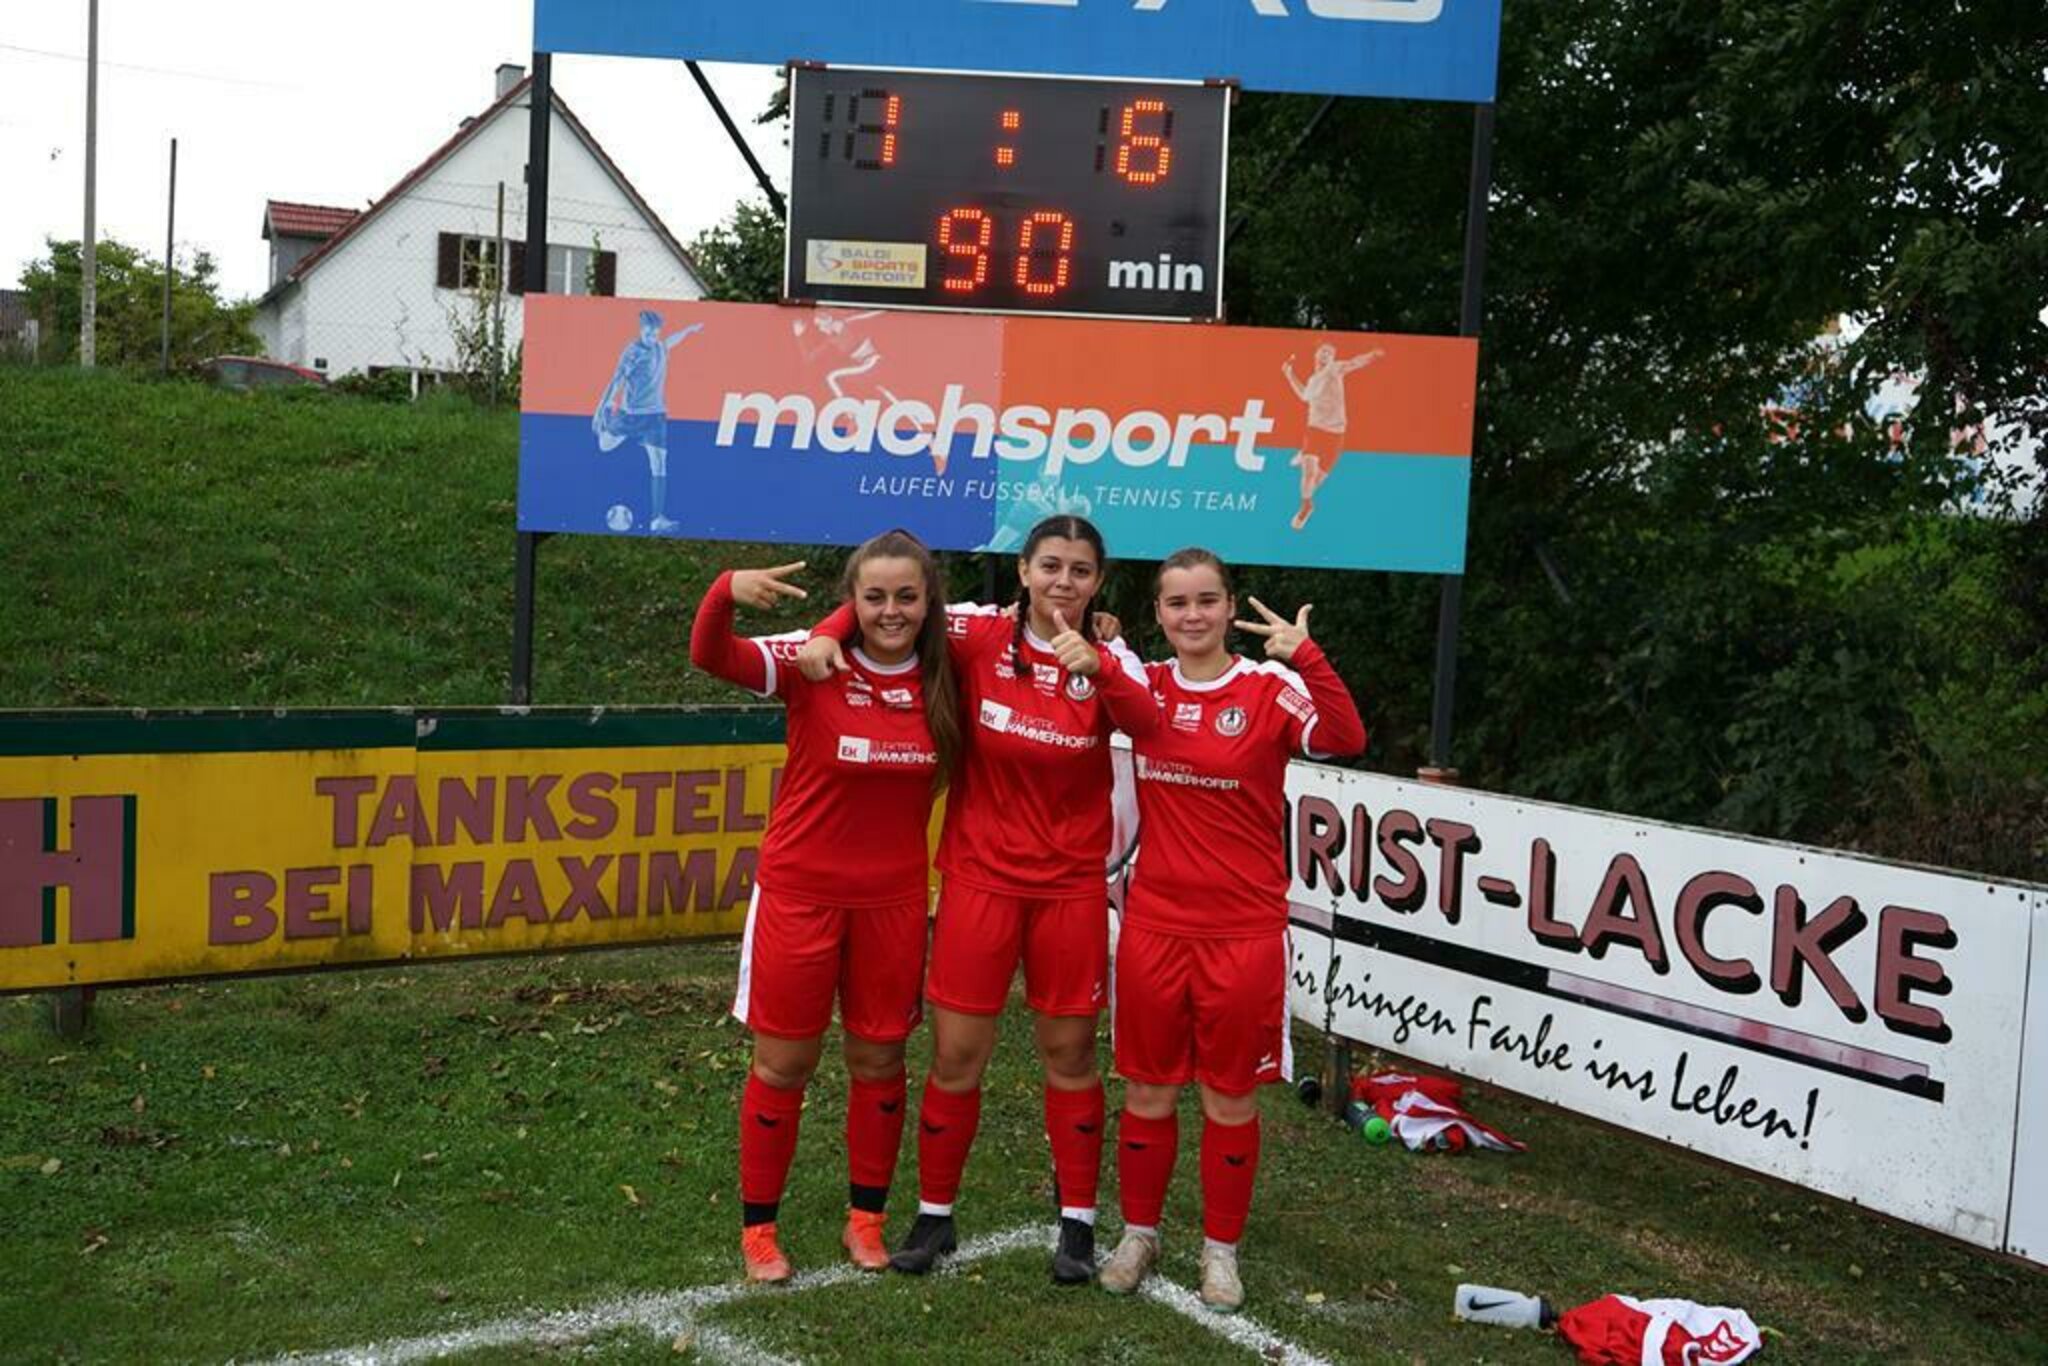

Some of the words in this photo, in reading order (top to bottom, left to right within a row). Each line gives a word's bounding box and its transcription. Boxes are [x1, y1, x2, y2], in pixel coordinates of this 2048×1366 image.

[1117, 100, 1170, 183] 6
[840, 271, 917, 283] FACTORY
[852, 259, 919, 273] SPORTS
[938, 208, 1073, 294] 90
[1107, 253, 1205, 292] min
[715, 383, 1275, 476] machsport
[858, 475, 955, 499] LAUFEN
[964, 479, 1083, 503] FUSSBALL
[1094, 485, 1183, 510] TENNIS
[1193, 490, 1259, 513] TEAM
[208, 863, 374, 947] BEI
[1284, 794, 1959, 1044] RIST-LACKE
[1323, 955, 1457, 1044] bringen
[1468, 995, 1573, 1072] Farbe
[1584, 1039, 1657, 1101] ins
[1669, 1051, 1821, 1150] Leben!
